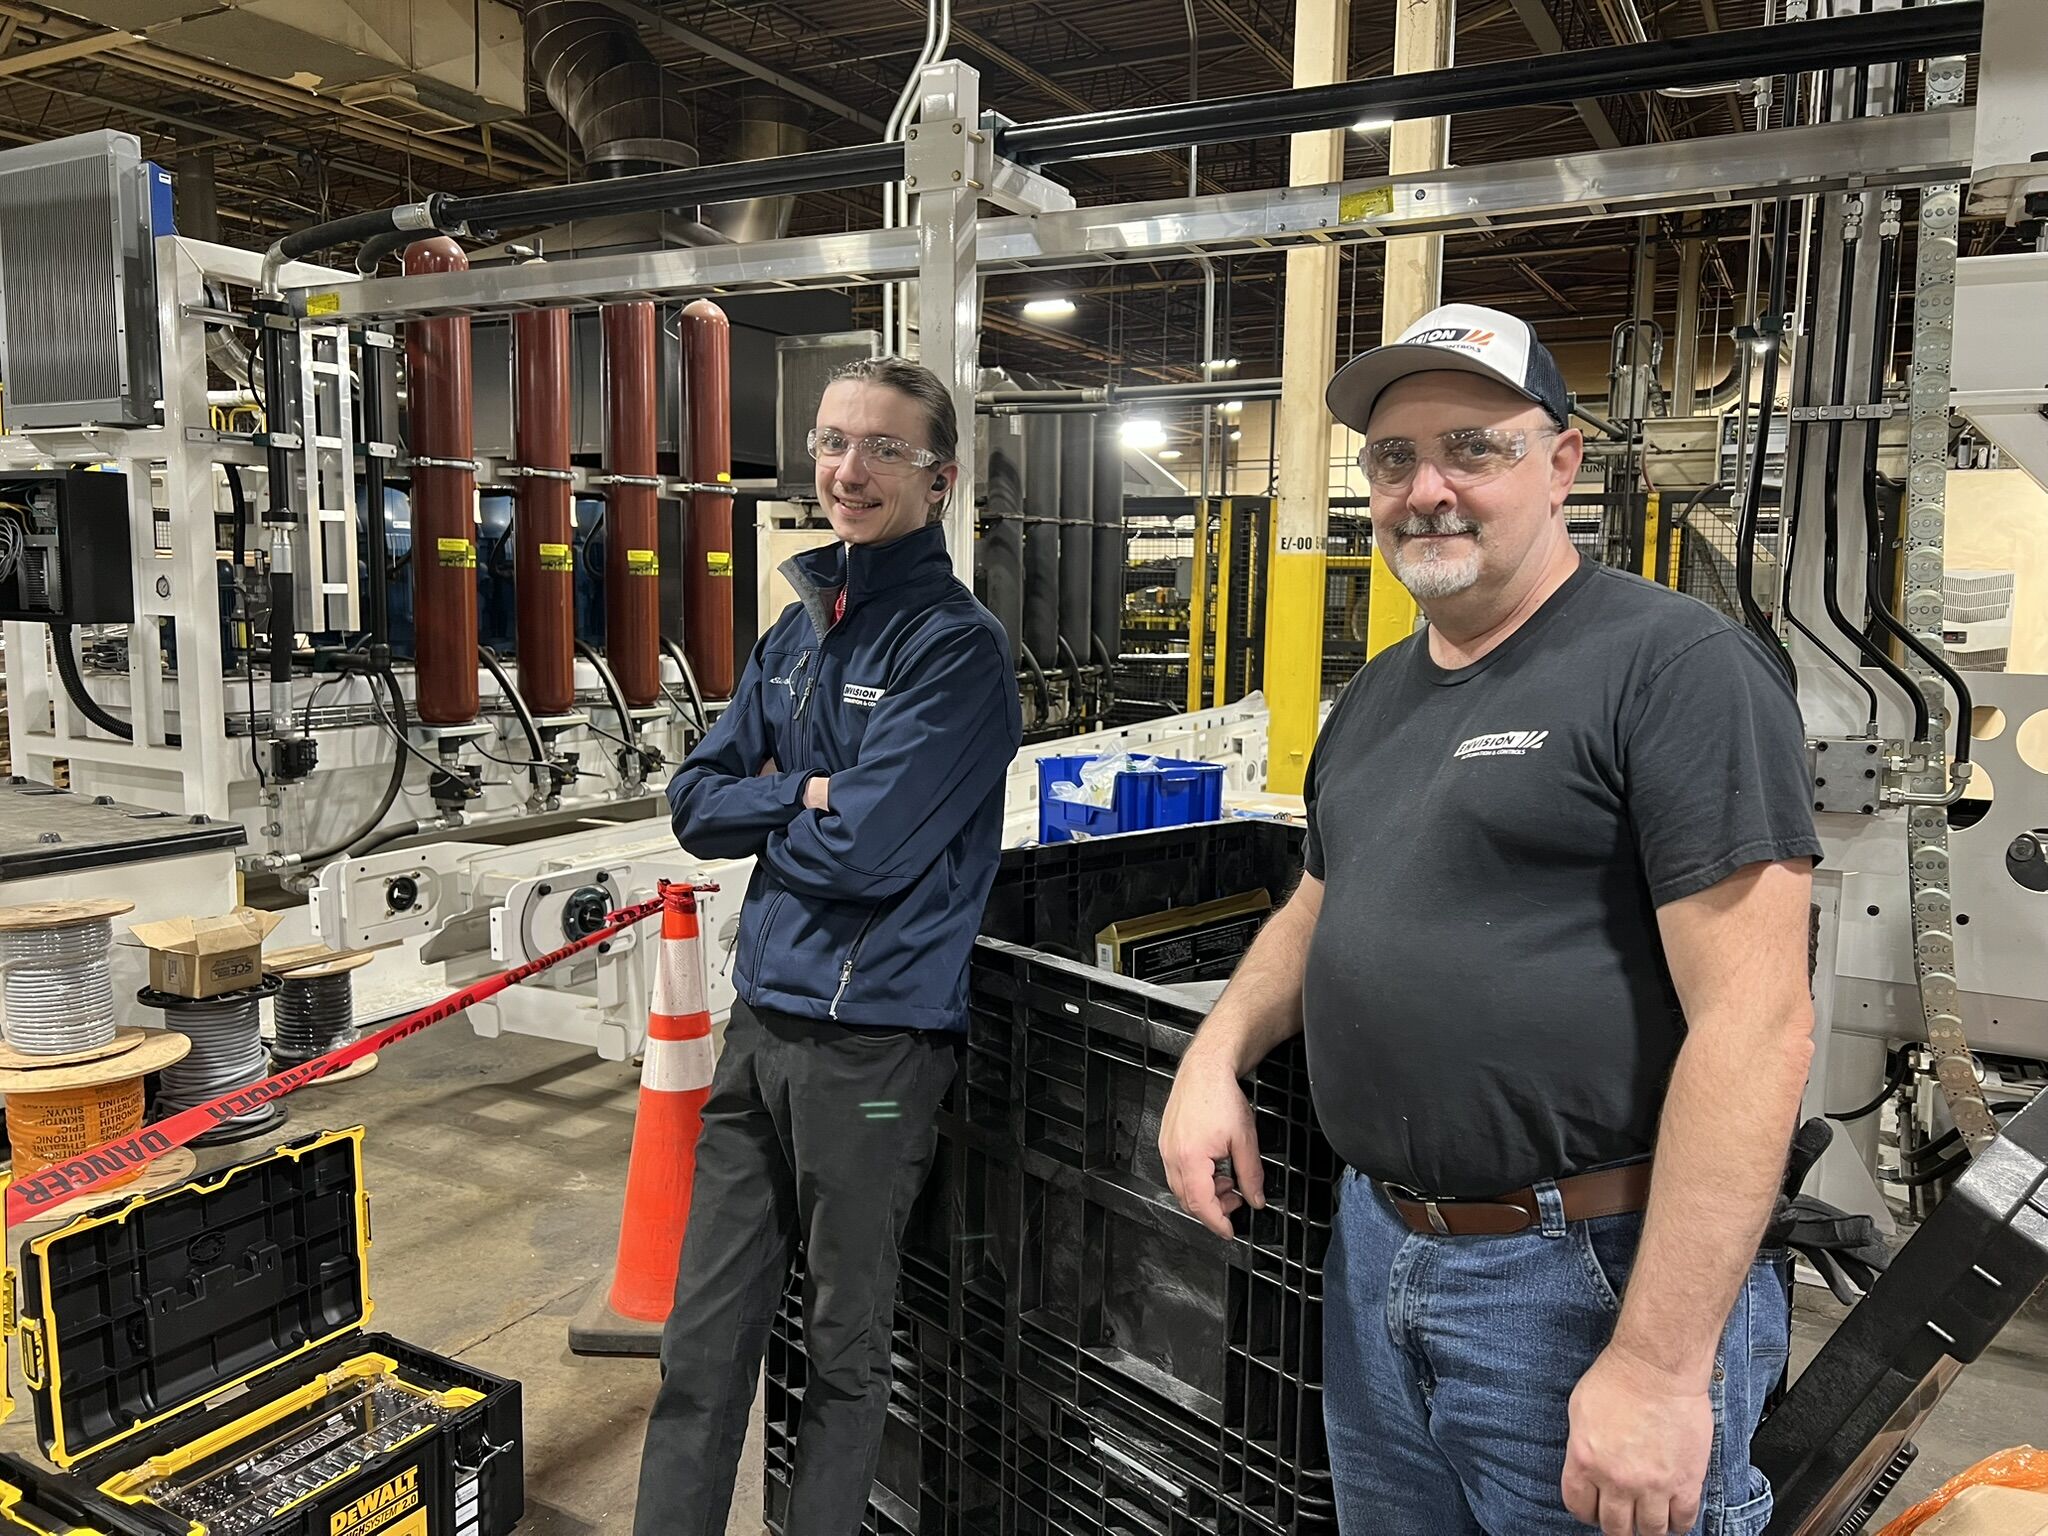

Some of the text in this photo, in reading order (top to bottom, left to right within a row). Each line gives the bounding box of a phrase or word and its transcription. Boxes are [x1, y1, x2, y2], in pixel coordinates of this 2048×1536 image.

[1459, 735, 1516, 754] ENVISION
[229, 961, 253, 976] SCE
[14, 1129, 174, 1205] DANGER
[401, 1493, 417, 1510] 2.0
